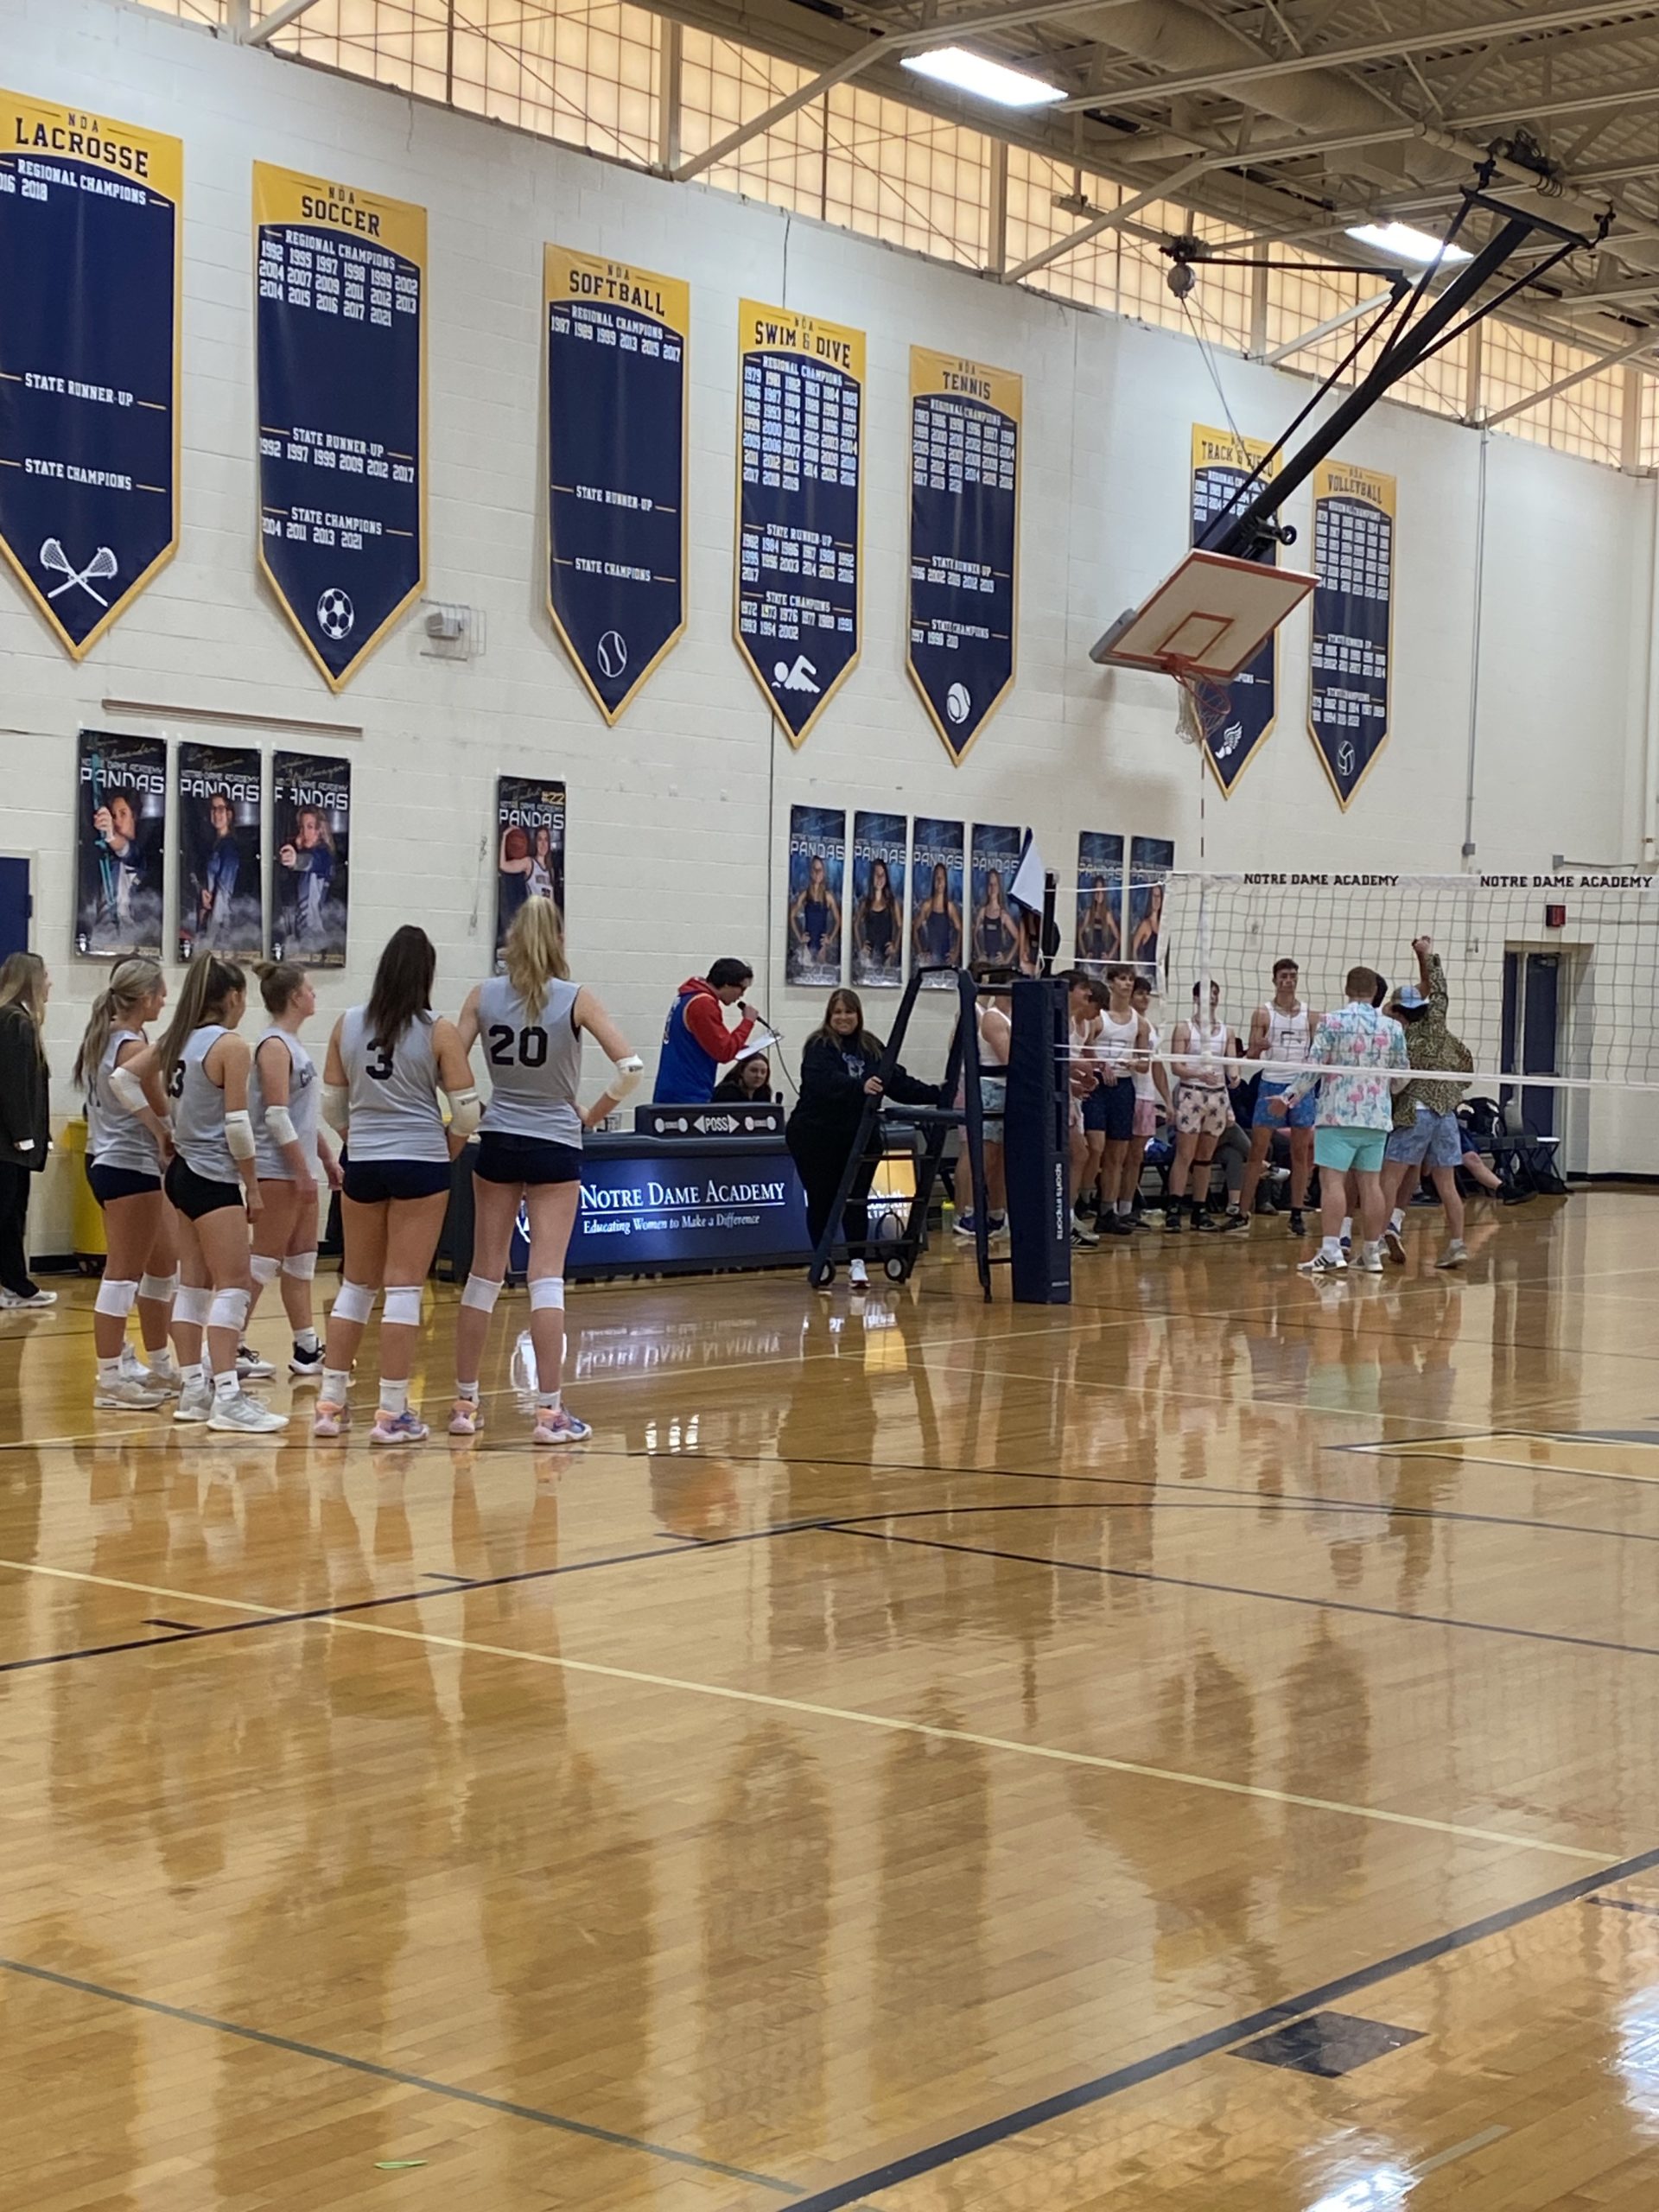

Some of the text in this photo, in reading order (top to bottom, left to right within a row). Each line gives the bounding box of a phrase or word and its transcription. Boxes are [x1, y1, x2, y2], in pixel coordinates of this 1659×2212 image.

[16, 118, 149, 177] LACROSSE
[17, 159, 146, 206] REGIONAL CHAMPIONS
[22, 178, 48, 201] 2018
[302, 195, 380, 238] SOCCER
[285, 230, 395, 270] REGIONAL CHAMPIONS
[287, 268, 312, 288] 2007
[345, 282, 364, 301] 2011
[371, 288, 391, 308] 2012
[316, 255, 338, 276] 1997
[395, 275, 418, 296] 2002
[260, 280, 283, 301] 2014
[316, 294, 338, 314] 2016
[343, 301, 365, 321] 2017
[569, 270, 664, 316] SOFTBALL
[572, 305, 663, 340] REGIONAL CHAMPIONS
[755, 321, 796, 346] SWIM
[817, 336, 850, 369] DIVE
[763, 355, 798, 375] REGIONAL
[801, 365, 842, 386] CHAMPIONS
[25, 372, 133, 407] STATE RUNNER-UP
[943, 372, 991, 400] TENNIS
[293, 427, 384, 458] STATE RUNNER-UP
[1202, 441, 1233, 461] TRACK
[25, 458, 132, 491] STATE CHAMPIONS
[287, 443, 308, 463] 1997
[314, 448, 335, 468] 1999
[367, 460, 389, 479] 2012
[392, 464, 414, 483] 2017
[576, 486, 602, 501] STATE
[1328, 474, 1382, 505] VOLLEYBALL
[286, 523, 306, 541] 2011
[291, 507, 382, 535] STATE CHAMPIONS
[767, 524, 788, 538] STATE
[575, 557, 651, 582] STATE CHAMPIONS
[932, 556, 954, 570] STATE
[766, 591, 787, 606] STATE
[931, 619, 953, 632] STATE
[80, 767, 164, 793] PANDAS
[180, 779, 259, 802] PANDAS
[499, 809, 564, 830] PANDAS
[790, 840, 844, 861] PANDAS
[855, 846, 906, 865] PANDAS
[914, 851, 963, 870] PANDAS
[972, 856, 1019, 874] PANDAS
[1243, 874, 1400, 887] NOTRE DAME ACADEMY
[1480, 875, 1653, 888] NOTRE DAME ACADEMY
[365, 1038, 394, 1080] 3
[489, 1025, 548, 1068] 20
[705, 1117, 728, 1132] POSS
[583, 1212, 760, 1236] Educating Women to Make a Difference
